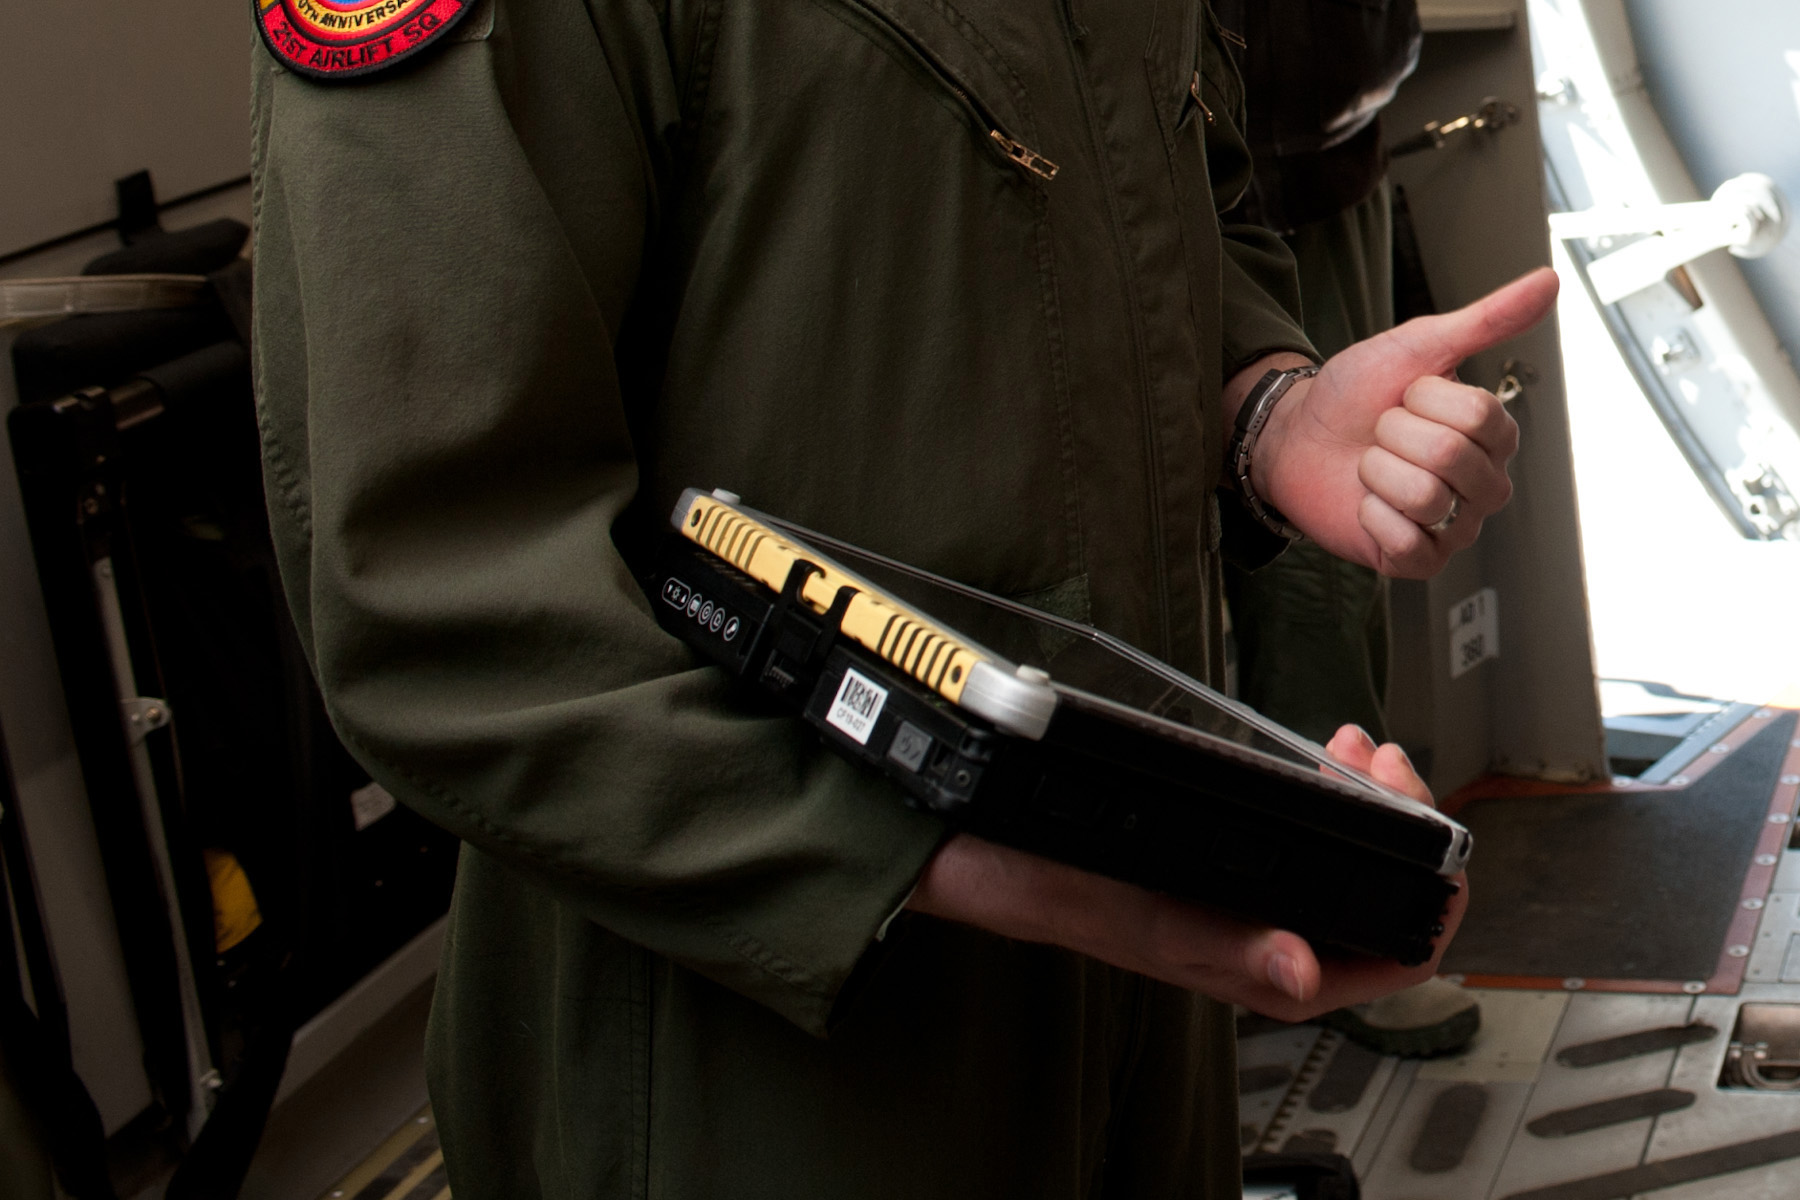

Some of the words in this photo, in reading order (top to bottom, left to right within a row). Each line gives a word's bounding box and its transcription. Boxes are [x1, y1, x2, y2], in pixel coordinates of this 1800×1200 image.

[273, 21, 308, 60] 21ST
[308, 36, 395, 68] AIRLIFT
[402, 12, 443, 43] SQ
